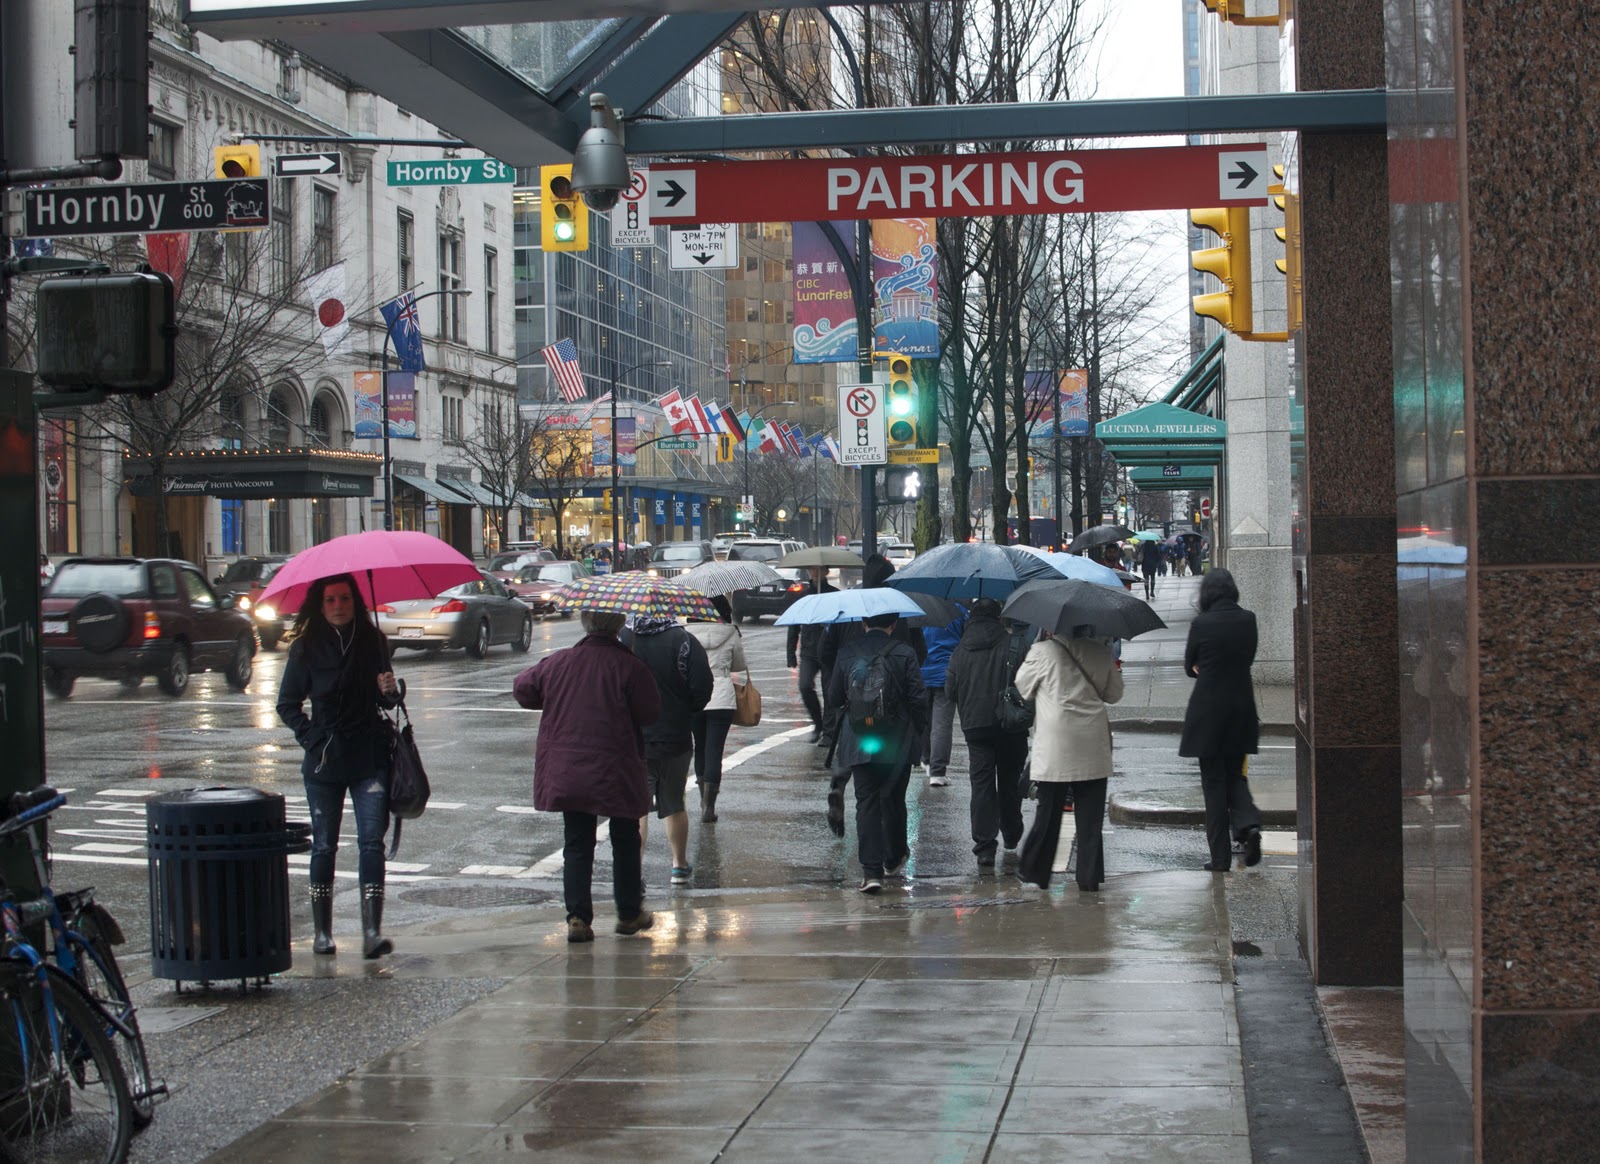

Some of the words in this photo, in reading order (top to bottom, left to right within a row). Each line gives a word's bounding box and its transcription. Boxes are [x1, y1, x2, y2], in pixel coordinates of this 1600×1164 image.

[396, 162, 472, 183] Hornby
[482, 160, 506, 179] St
[827, 160, 1085, 211] PARKING
[36, 188, 166, 230] Hornby
[190, 186, 206, 203] St
[183, 203, 214, 220] 600
[685, 243, 723, 251] MON-FRI
[796, 261, 847, 275] 恭賀新
[796, 279, 820, 289] CIBC
[797, 290, 852, 302] LunarFest
[1102, 424, 1151, 433] LUCINDA
[1152, 424, 1217, 433] JEWELLERS
[660, 441, 685, 449] Burrard
[687, 441, 695, 449] St
[848, 446, 877, 454] EXCEPT
[162, 476, 209, 492] Fairmont
[210, 481, 233, 489] HOTEL
[234, 480, 275, 488] VANCOUVER
[656, 500, 664, 515] Bell
[676, 502, 684, 516] Bell
[692, 503, 700, 517] Bell
[569, 525, 590, 536] Bell
